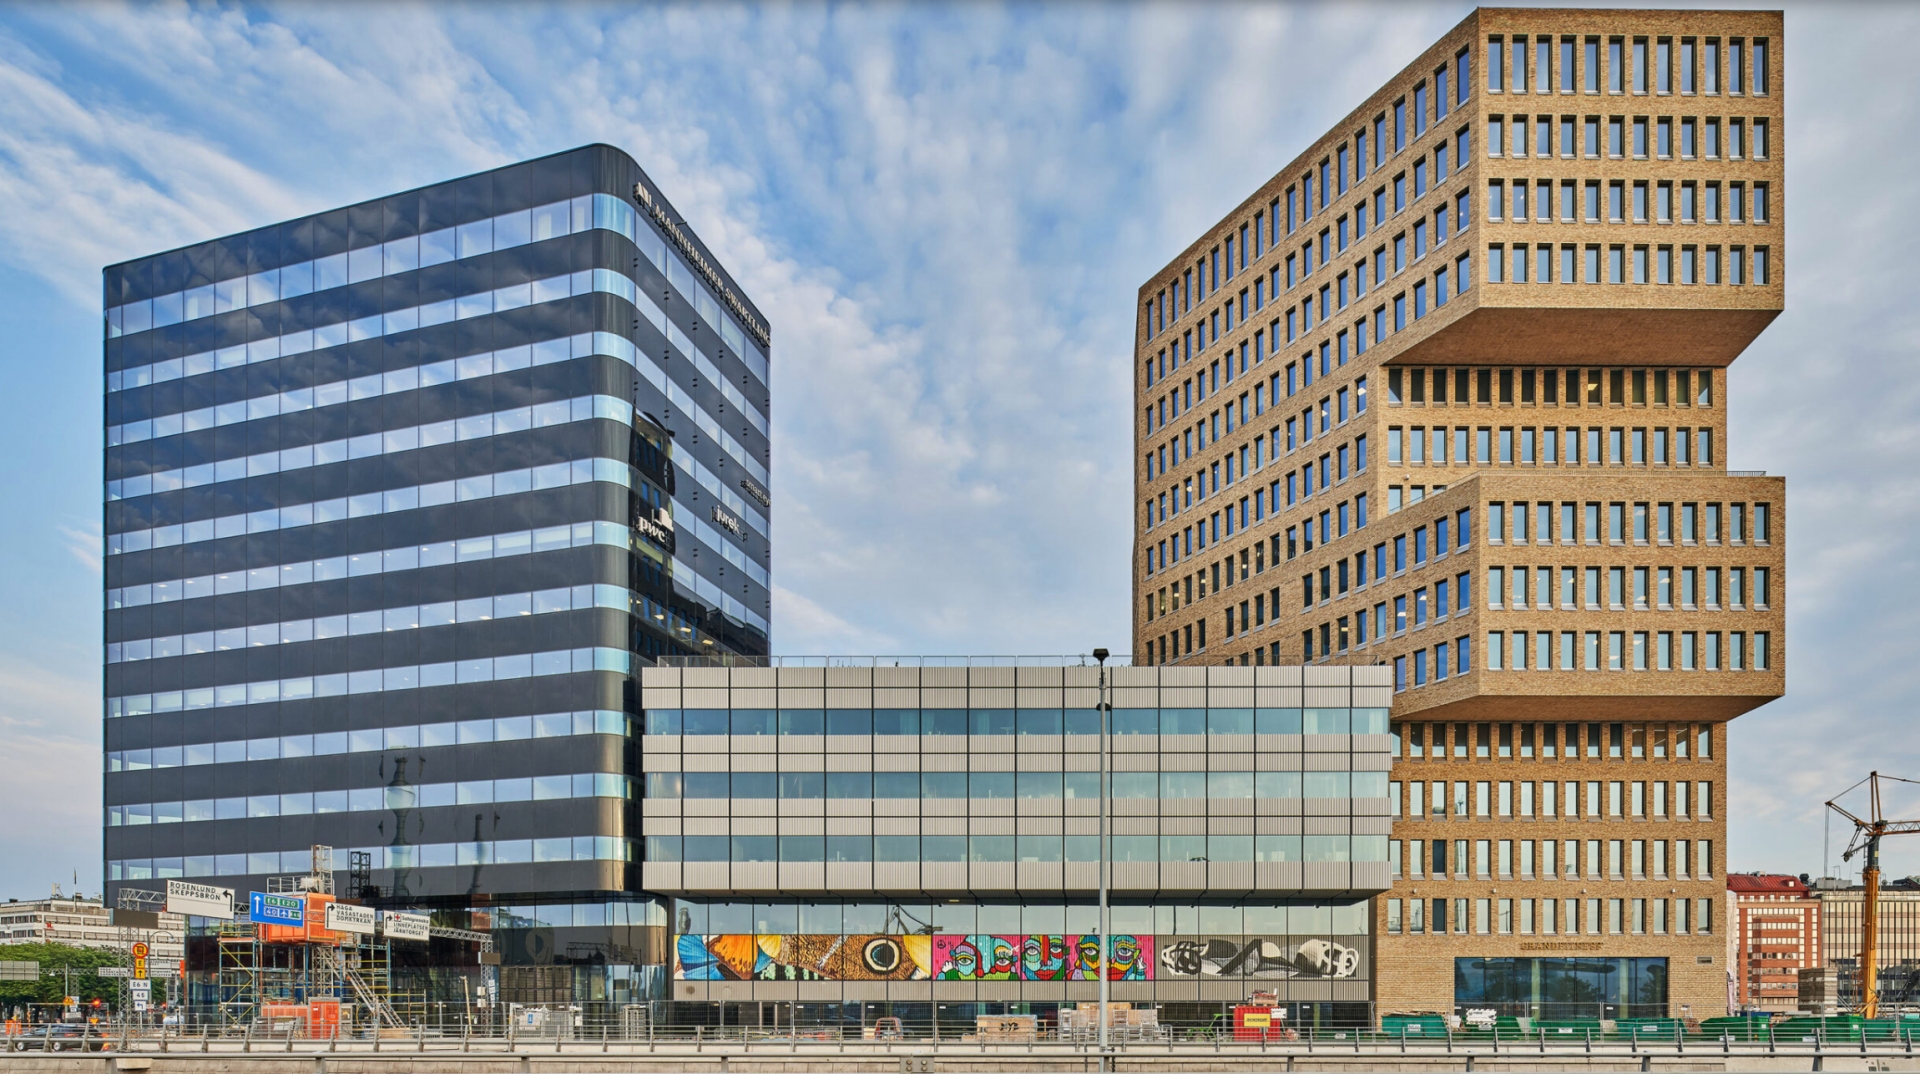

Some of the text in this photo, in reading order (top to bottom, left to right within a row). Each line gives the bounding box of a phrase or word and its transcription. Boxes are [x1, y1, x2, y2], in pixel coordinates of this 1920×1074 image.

[655, 203, 723, 291] MANNHEIMER
[716, 504, 740, 534] jurek
[638, 516, 666, 542] pwc
[169, 881, 216, 894] ROSENLUND
[169, 888, 221, 901] SKEPPSBRON
[266, 907, 277, 915] 40
[336, 910, 374, 919] VASASTADEN
[336, 915, 372, 924] DOMKYRKAN
